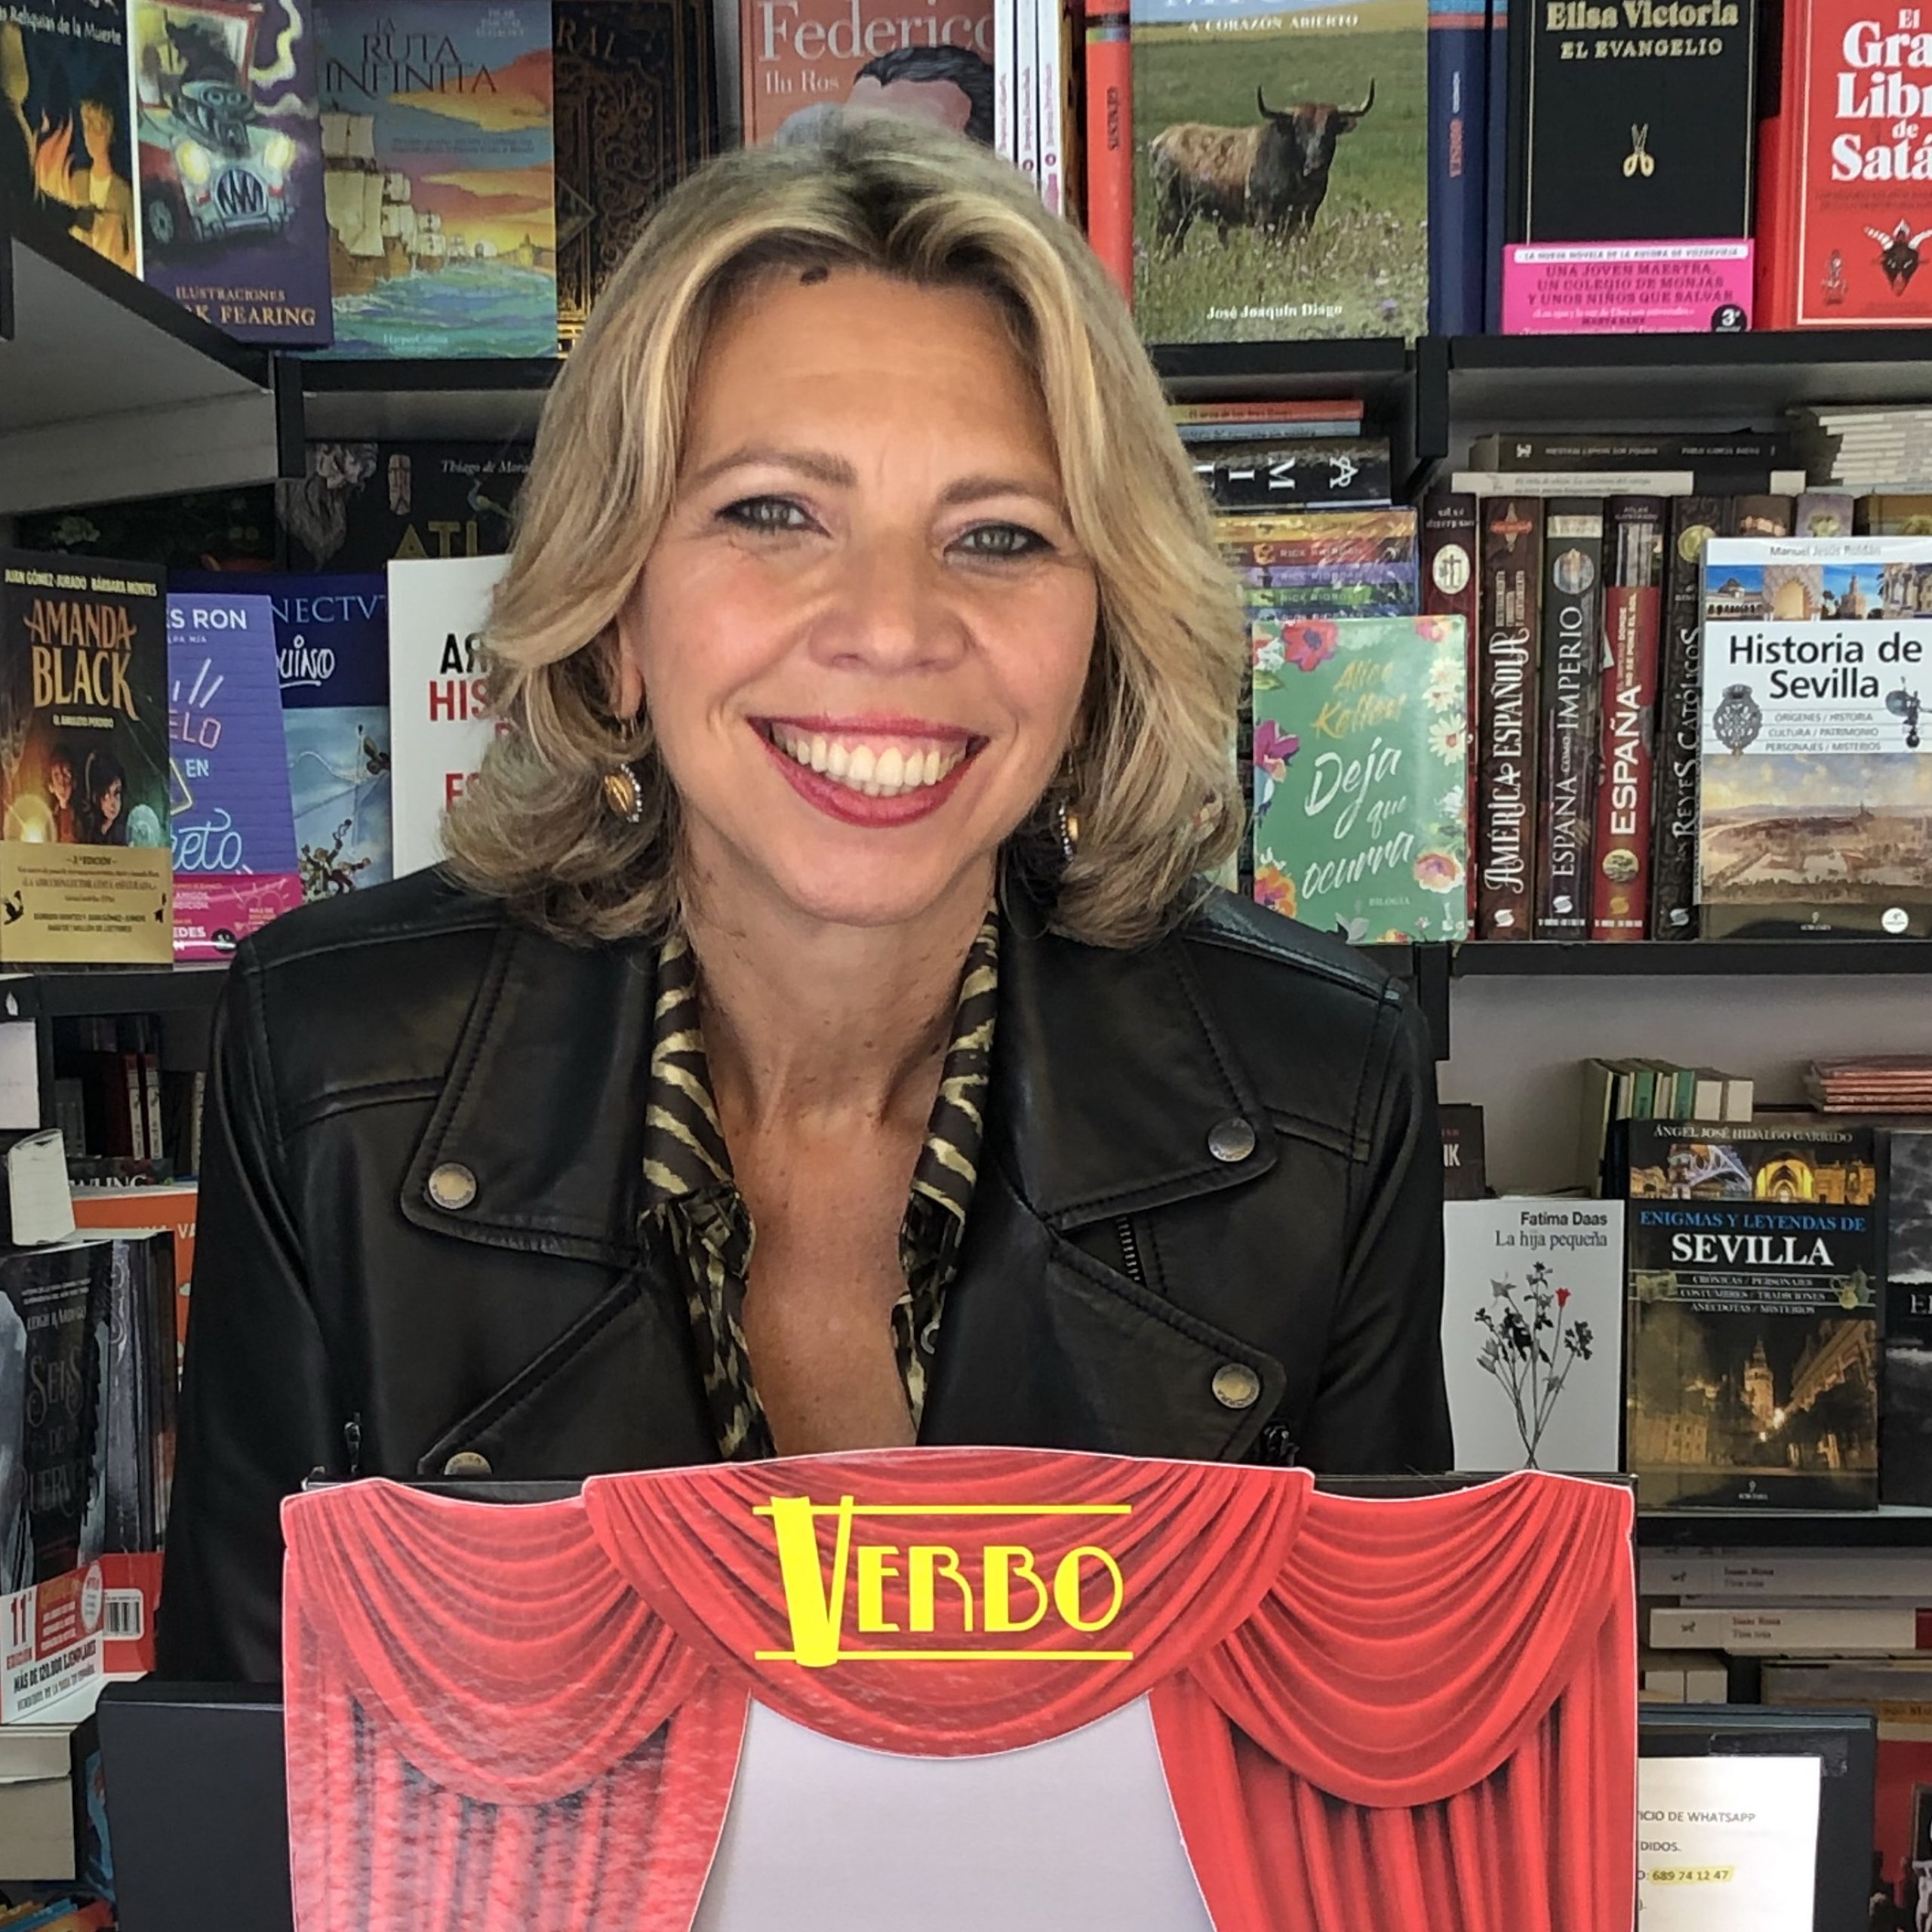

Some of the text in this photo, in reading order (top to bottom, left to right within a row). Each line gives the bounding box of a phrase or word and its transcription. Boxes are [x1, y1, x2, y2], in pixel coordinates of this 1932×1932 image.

[1189, 14, 1358, 33] A CORAZÓN ABIERTO
[1546, 0, 1739, 30] Elisa Victoria
[1898, 8, 1920, 29] El
[362, 35, 460, 63] RUTA
[1561, 38, 1723, 60] EL EVANGELIO
[325, 58, 497, 100] INFINITA
[801, 70, 839, 92] Ros
[1892, 119, 1918, 139] de
[1546, 266, 1577, 278] UNA
[1583, 264, 1632, 277] JOVEN
[175, 286, 286, 303] ILUSTRACIONES
[1537, 276, 1724, 291] UN COLEGIO DE MONJAS
[1528, 294, 1537, 306] Y
[1540, 294, 1583, 305] UNOS
[1586, 291, 1635, 304] NIÑOS
[1639, 291, 1672, 303] QUE
[221, 305, 316, 327] FEARING
[1207, 303, 1342, 320] José Joaquín Diago
[482, 461, 496, 472] de
[1281, 549, 1306, 558] RICK
[1770, 546, 1810, 557] Manuel
[1813, 545, 1841, 556] Jesús
[166, 608, 247, 629] S RON
[271, 595, 386, 623] NECTV
[23, 598, 137, 651] AMANDA
[276, 635, 334, 679] UINO
[1730, 632, 1922, 664] Historia de
[1557, 605, 1583, 730] IMPERIO
[32, 645, 140, 721] BLACK
[1489, 627, 1531, 757] ESPAÑOLA
[1675, 628, 1700, 750] CATÓLICOS
[1769, 667, 1878, 699] Sevilla
[1830, 712, 1873, 721] HISTORIA
[1768, 728, 1878, 737] CULTURA PATRIMONIO
[1766, 742, 1881, 752] PERSONAJES MISTERIOS
[185, 758, 209, 777] EN
[1610, 684, 1642, 835] ESPAÑA
[1304, 737, 1403, 839] Deja
[1672, 761, 1696, 838] REYES
[1367, 795, 1407, 839] que
[1484, 762, 1526, 894] AMÉRICA
[1550, 774, 1578, 878] ESPAÑA
[1302, 831, 1414, 899] ocurra
[1654, 1124, 1853, 1143] ÁNGEL JOSÉ HIDALGO GARRIDO
[1521, 1211, 1607, 1226] Fatima Daas
[1641, 1211, 1866, 1232] ENIGMAS Y LEYENDAS DE
[1496, 1230, 1607, 1251] La hija pequeña
[1671, 1233, 1835, 1266] SEVILLA
[771, 1495, 1124, 1667] VERBO
[14, 1670, 28, 1694] MÁS
[30, 1671, 38, 1686] DE
[1668, 1811, 1684, 1822] DE
[1687, 1812, 1756, 1823] WHATSAPP
[1653, 1871, 1675, 1881] 689
[1679, 1871, 1692, 1880] 74
[1698, 1871, 1709, 1880] 12
[1714, 1870, 1729, 1879] 47
